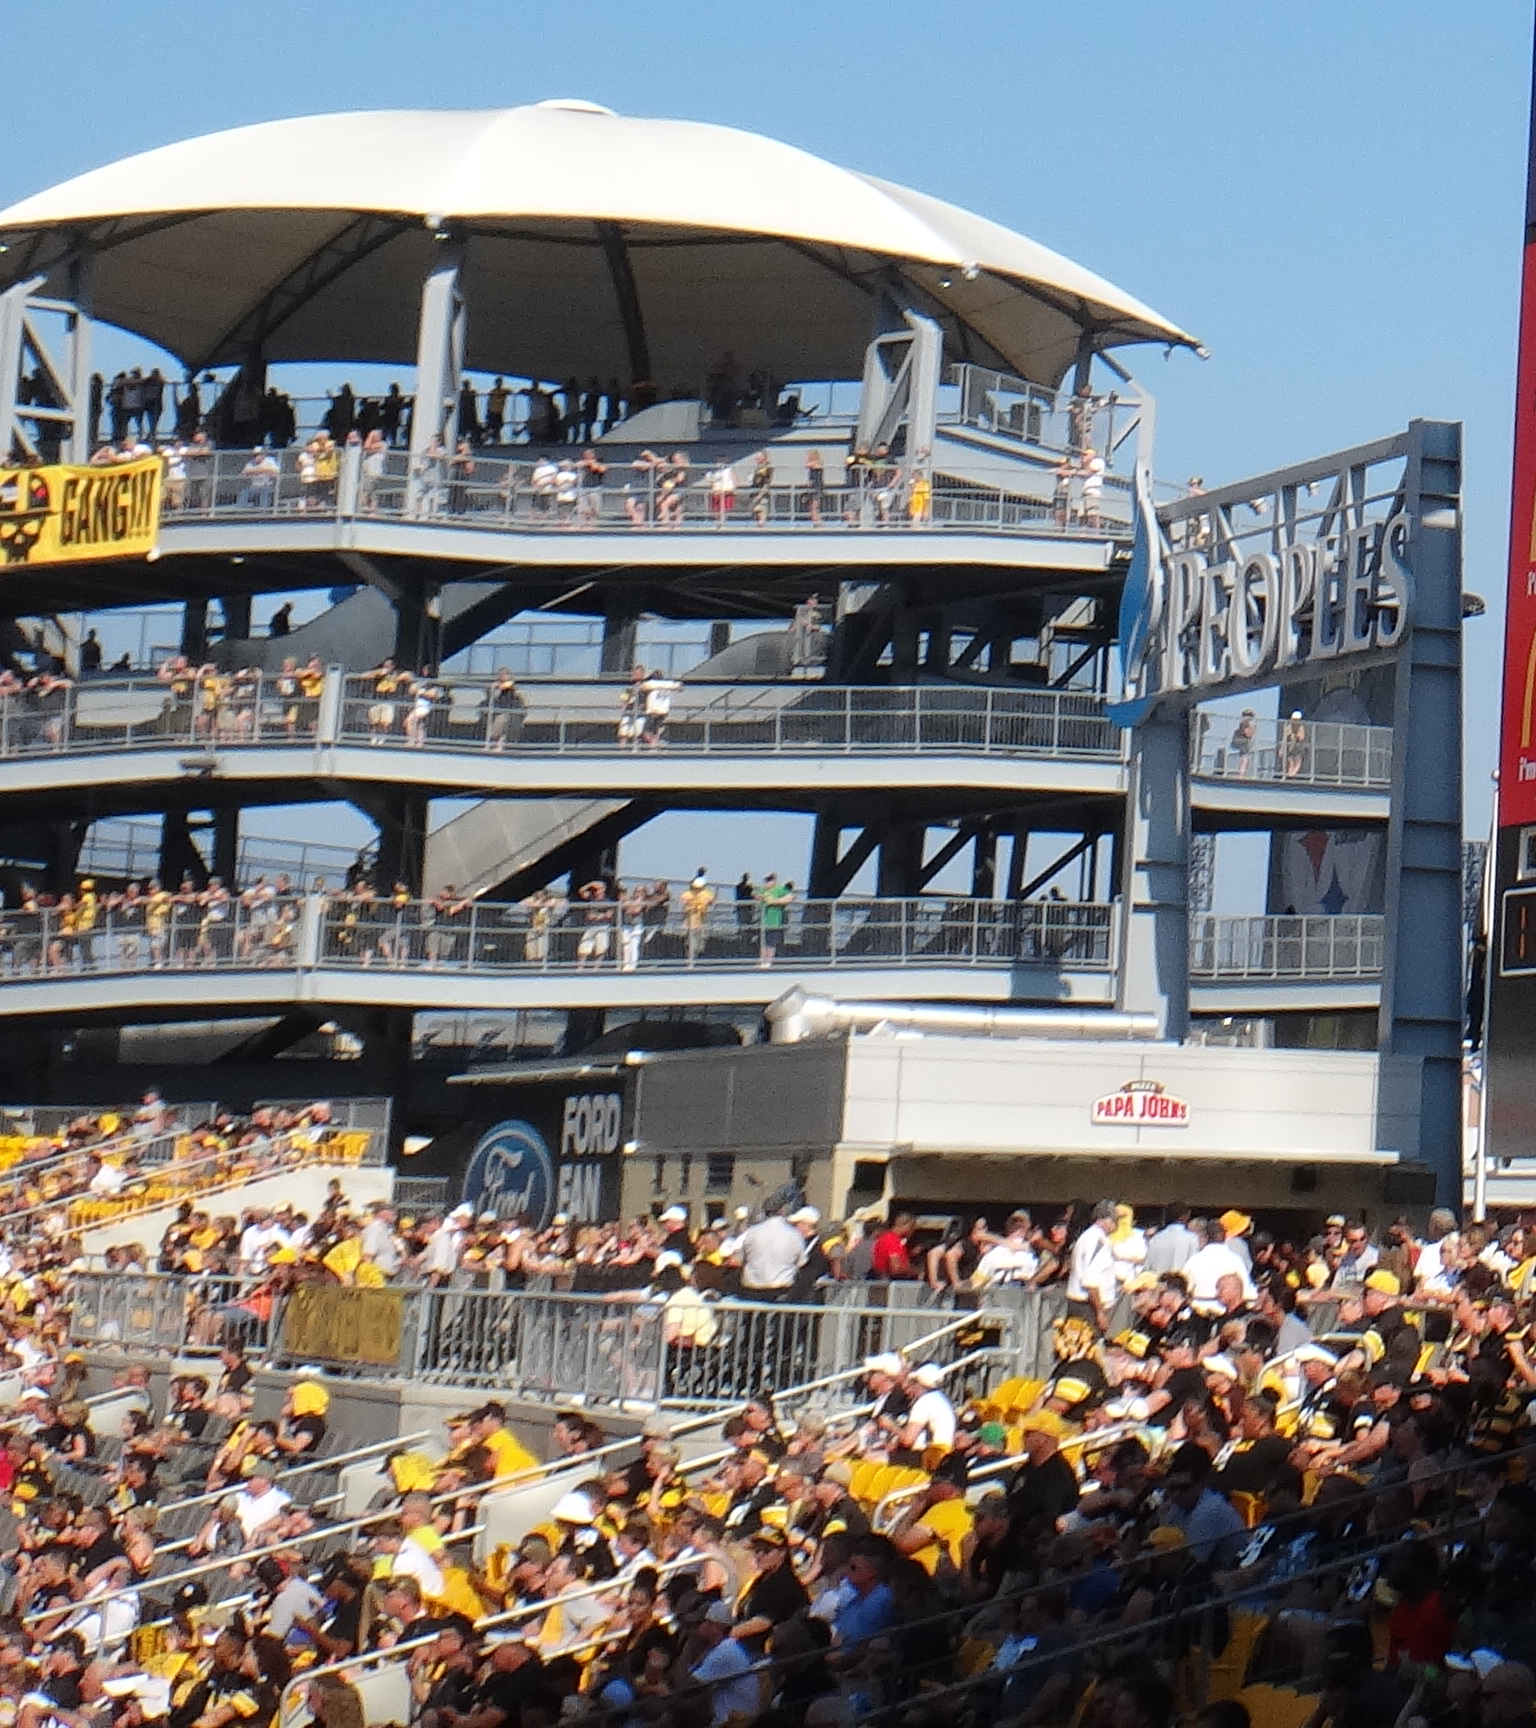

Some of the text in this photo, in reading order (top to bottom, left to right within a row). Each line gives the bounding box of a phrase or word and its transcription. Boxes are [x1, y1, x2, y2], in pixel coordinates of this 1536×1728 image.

[1160, 514, 1412, 694] PEOPLES
[1518, 757, 1535, 782] i'm
[561, 1092, 623, 1156] FORD
[1097, 1095, 1134, 1117] PAPA
[558, 1162, 601, 1222] FAN
